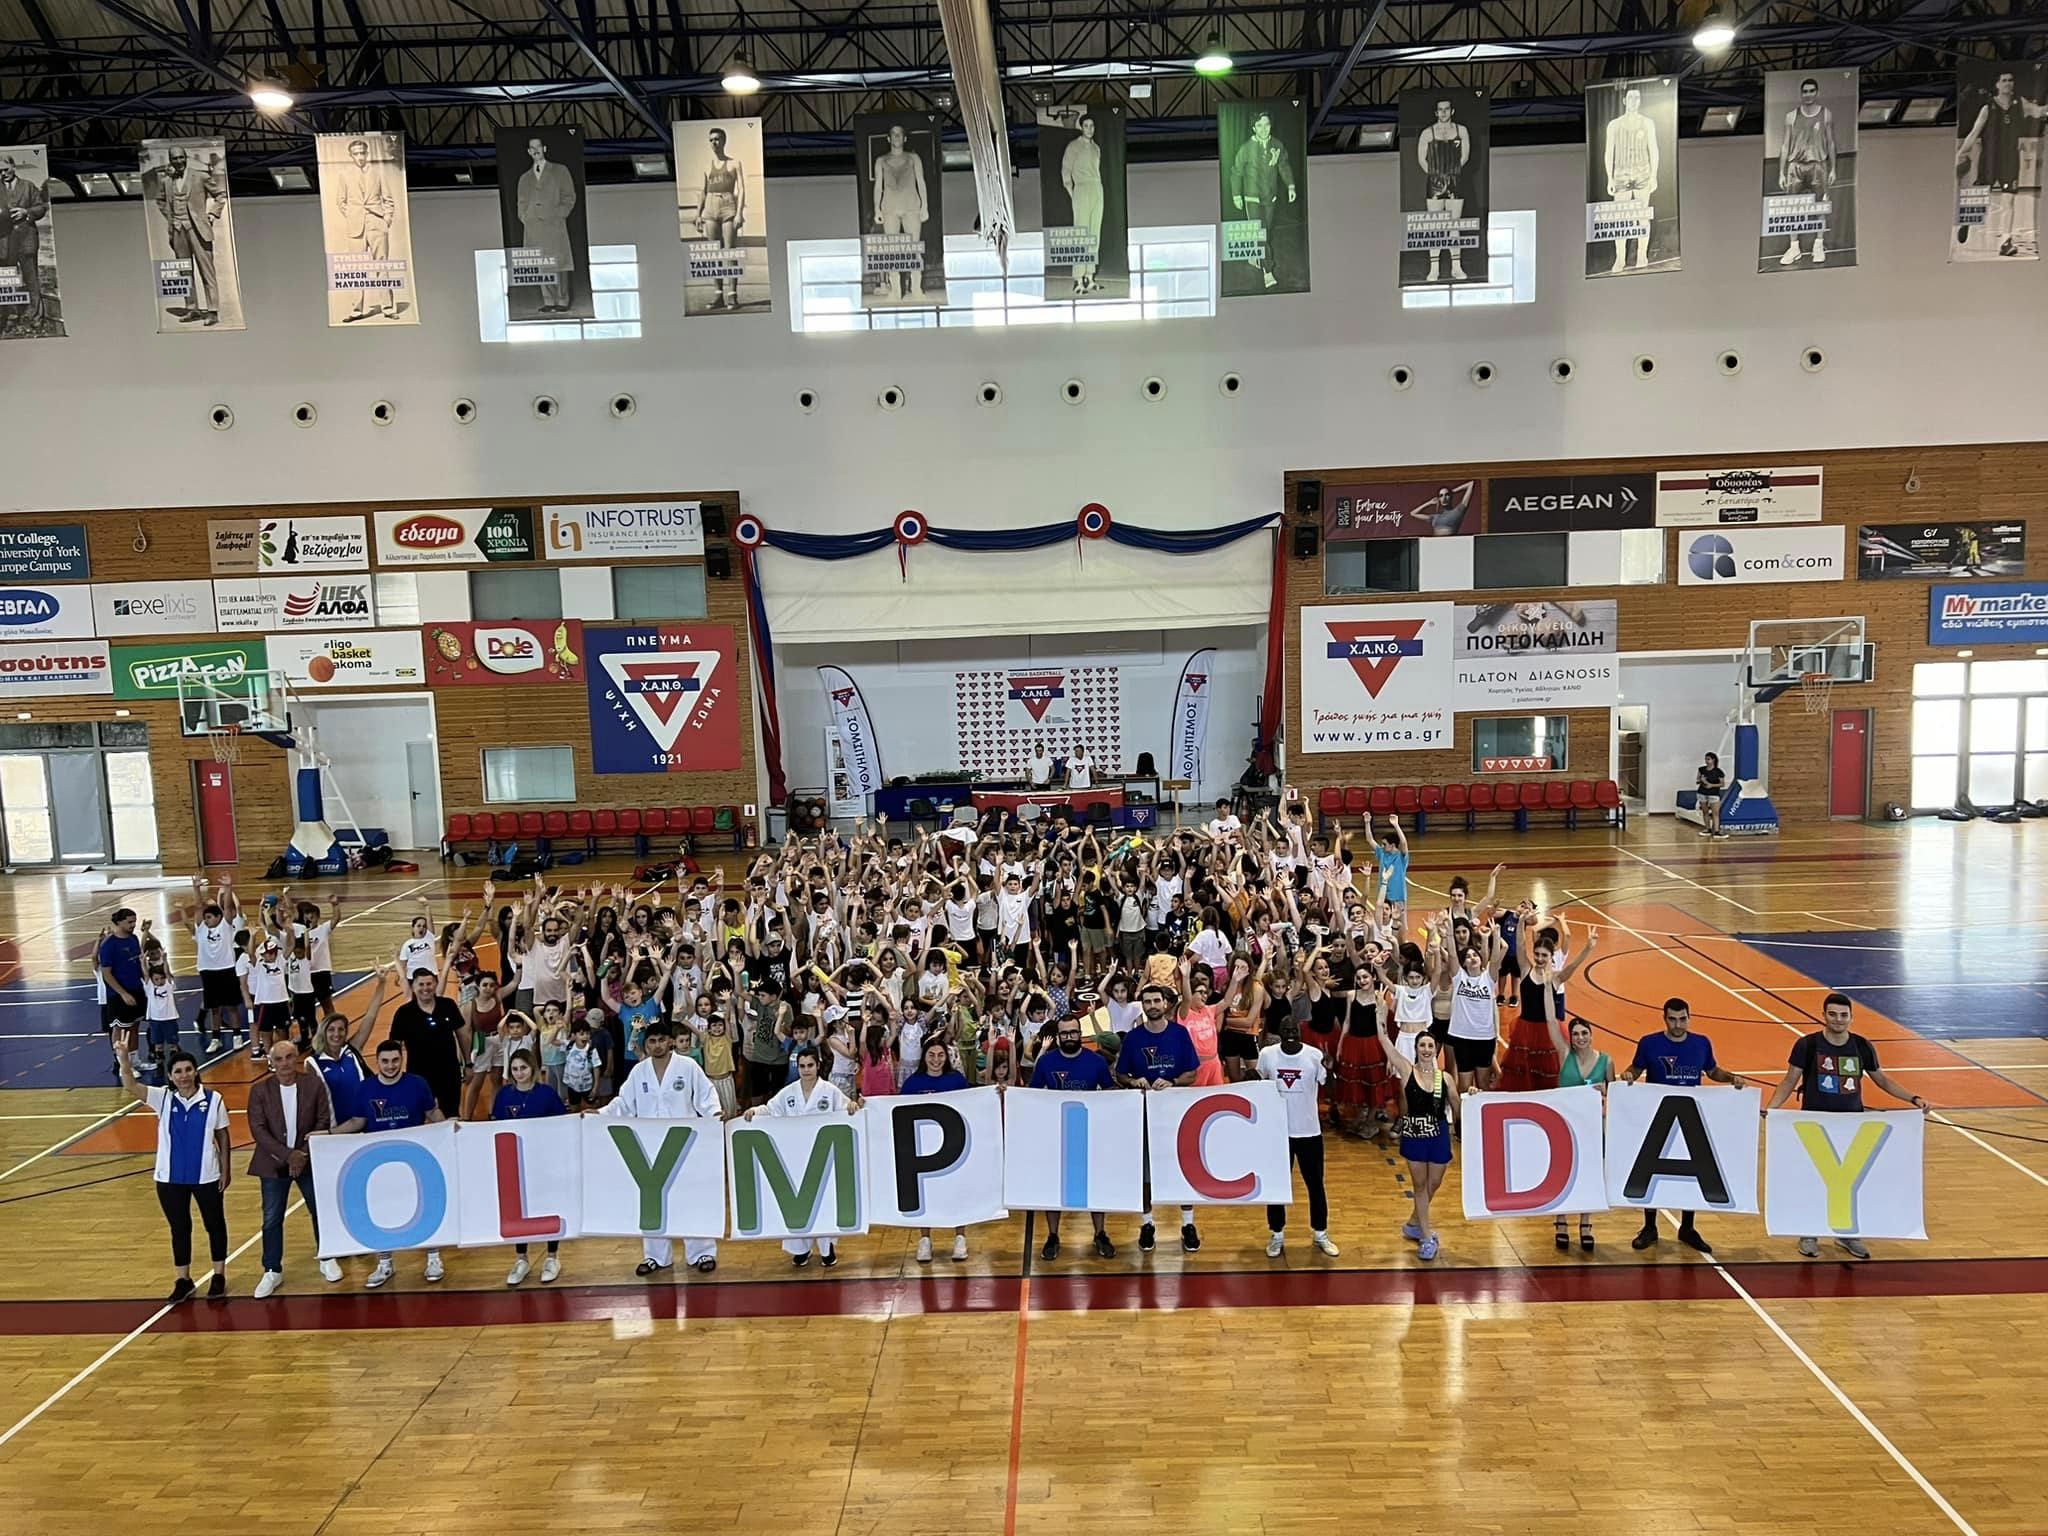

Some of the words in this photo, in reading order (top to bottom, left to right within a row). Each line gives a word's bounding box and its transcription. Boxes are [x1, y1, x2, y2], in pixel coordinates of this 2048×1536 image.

[1594, 220, 1634, 231] DIONISIS
[1768, 215, 1806, 225] SOTIRIS
[1594, 228, 1647, 240] ANANIADIS
[1767, 222, 1823, 234] NIKOLAIDIS
[1407, 231, 1445, 240] MIHALIS
[1050, 246, 1086, 254] GIORGOS
[1228, 241, 1255, 249] LAKIS
[1407, 239, 1477, 249] GIANNOUZAKOS
[867, 253, 916, 261] THEODOROS
[1050, 255, 1095, 263] TRONTZOS
[1228, 249, 1262, 258] TSAVAS
[513, 266, 539, 275] MIMIS
[867, 261, 921, 270] RODOPOULOS
[334, 271, 368, 280] SIMEON
[162, 278, 189, 287] LEWIS
[335, 279, 402, 289] MAVROSKOUFIS
[1356, 498, 1388, 513] Embrace
[1505, 493, 1614, 512] AEGEAN
[586, 508, 697, 528] INFOTRUST
[1355, 513, 1374, 529] your
[1376, 510, 1403, 528] beauty
[400, 523, 459, 545] εδεσμα
[487, 526, 513, 538] 100
[588, 530, 638, 538] INSURANCE
[17, 533, 59, 547] College,
[487, 538, 528, 548] ΧΡΟΝΙΑ
[42, 546, 54, 558] of
[56, 545, 81, 557] York
[29, 560, 72, 574] Campus
[1743, 554, 1832, 570] com&com
[130, 593, 197, 616] exelixis
[315, 600, 369, 615] ΑΛΦΑ
[1946, 597, 1976, 616] My
[1980, 593, 2048, 611] marke
[1942, 619, 1963, 629] εδώ
[1966, 618, 2004, 629] νιώθεις
[488, 637, 533, 656] Dole
[626, 635, 692, 646] ΠΝΕΥΜΑ
[1467, 631, 1604, 650] ΠΟΡΤΟΚΑΛΙΔΗ
[332, 649, 372, 659] basket
[1350, 643, 1402, 655] Χ.Α.Ν.Θ.
[641, 681, 684, 691] Χ.Α.Ν.Θ.
[605, 690, 637, 731] ΨΥΧΗ
[692, 688, 721, 729] ΣΩΜΑ
[1184, 702, 1197, 779] ΑΘΛΗΤΙΣΜΟΣ
[1313, 729, 1442, 743] www.ymca.gr
[652, 754, 682, 765] 1921
[336, 1093, 1260, 1250] OLYMPIC
[1480, 1095, 1891, 1234] DAY
